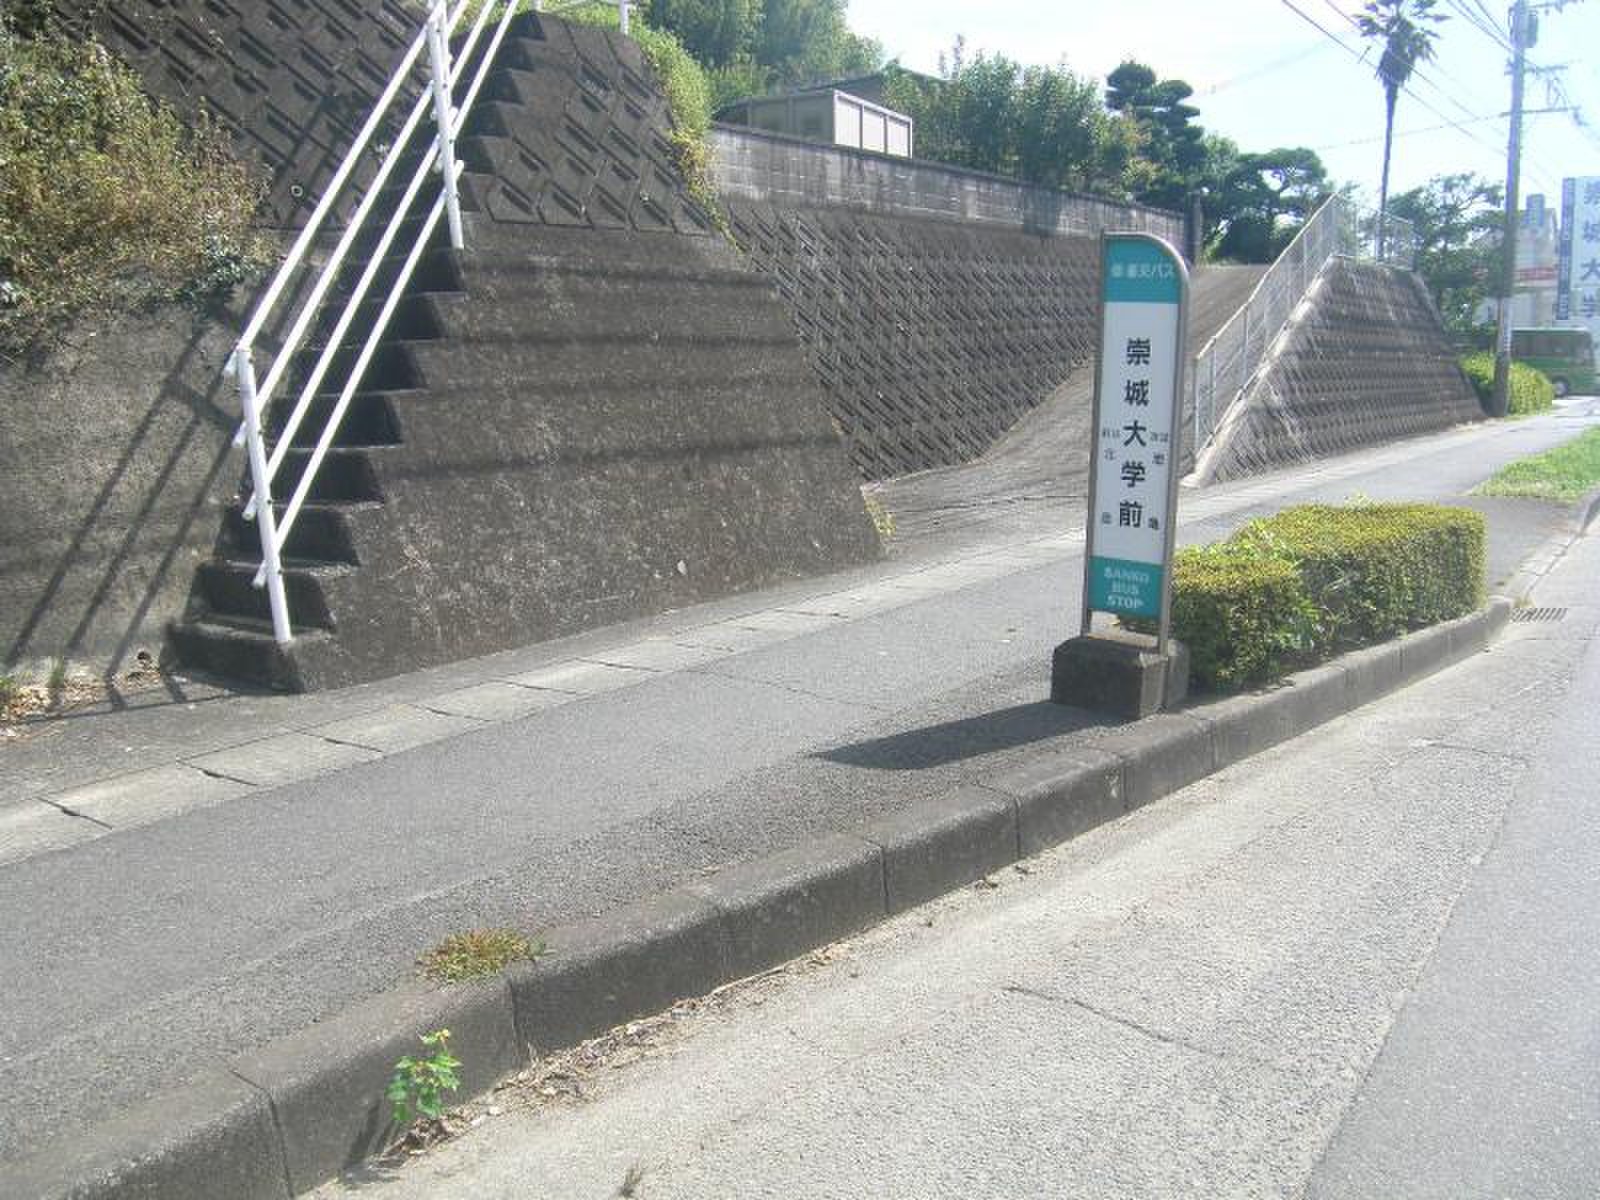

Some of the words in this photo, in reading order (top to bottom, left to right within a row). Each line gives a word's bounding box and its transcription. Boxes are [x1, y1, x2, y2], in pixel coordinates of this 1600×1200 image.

[1119, 339, 1151, 528] 崇城大学前
[1111, 579, 1140, 595] BUS
[1105, 594, 1144, 609] STOP
